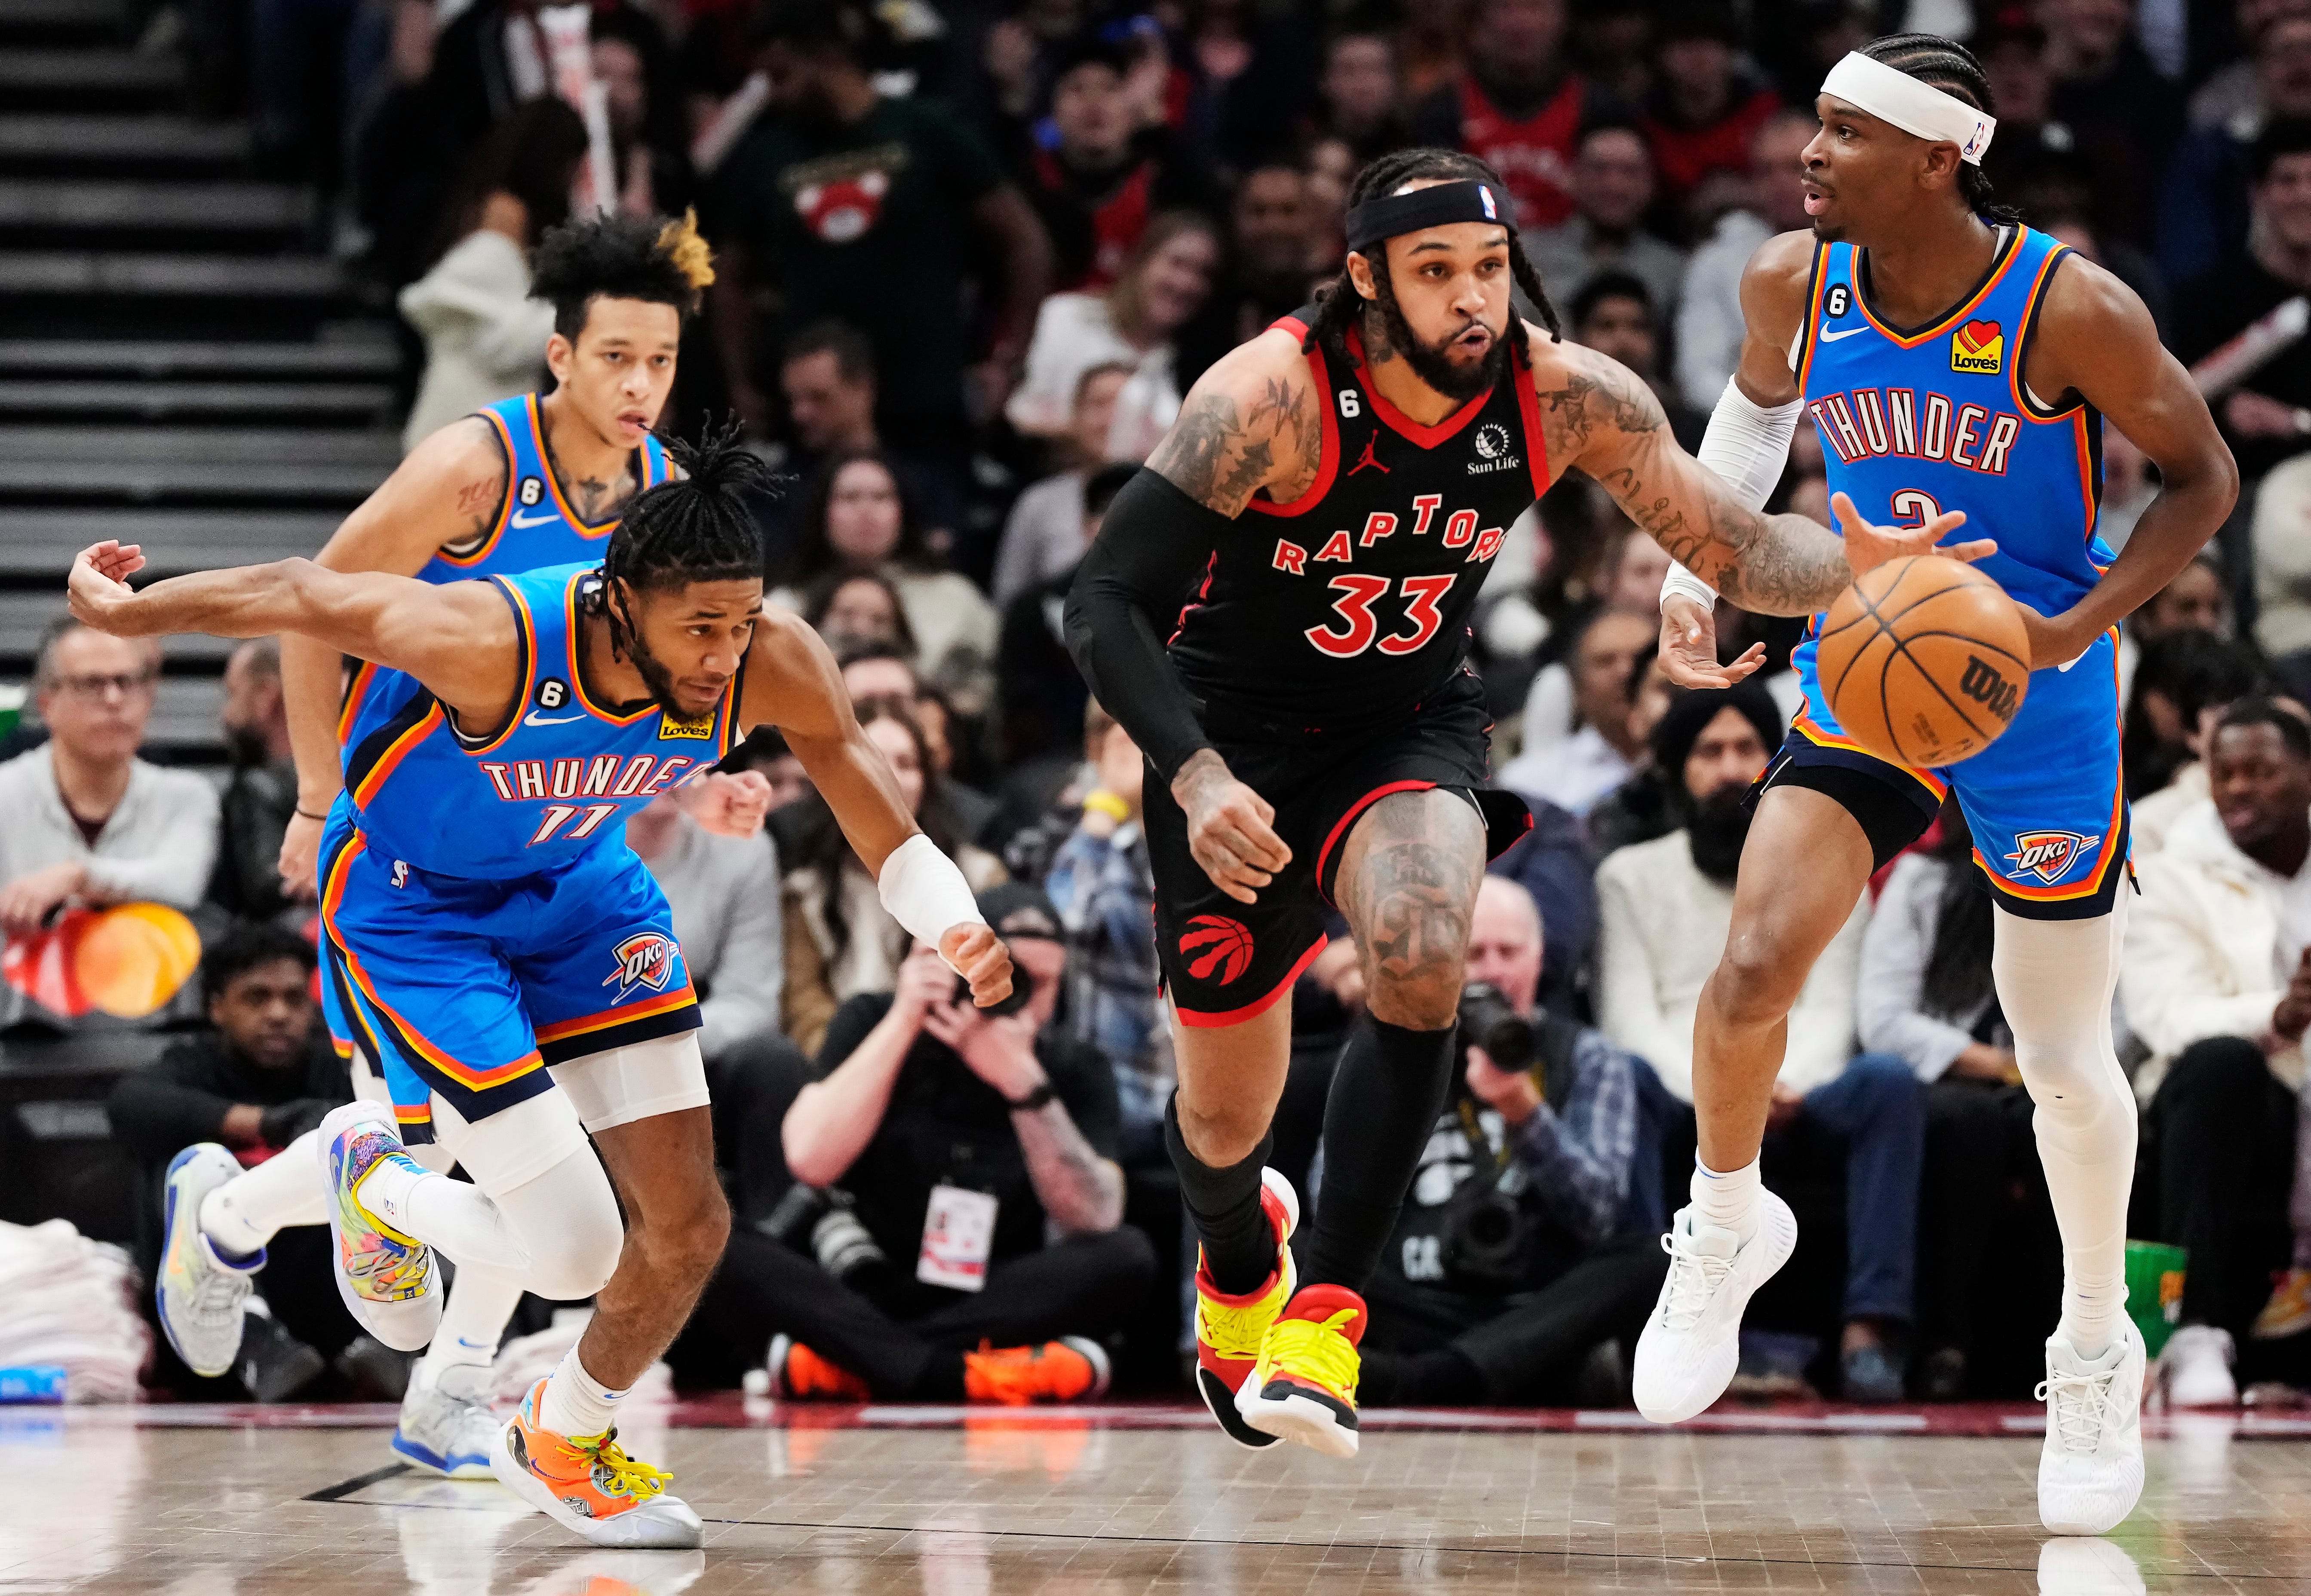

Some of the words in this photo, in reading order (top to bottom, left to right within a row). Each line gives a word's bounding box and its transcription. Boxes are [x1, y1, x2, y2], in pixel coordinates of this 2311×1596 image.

[1829, 288, 1847, 315] 6
[1338, 389, 1360, 418] 6
[1807, 388, 2021, 477] THUNDER
[1467, 462, 1493, 475] Sun
[1495, 455, 1520, 471] Life
[521, 478, 541, 506] 6
[1304, 573, 1458, 659] 33
[540, 681, 563, 708] 6
[525, 804, 620, 849] 11
[2018, 840, 2068, 870] OKC
[624, 942, 662, 985] OKC
